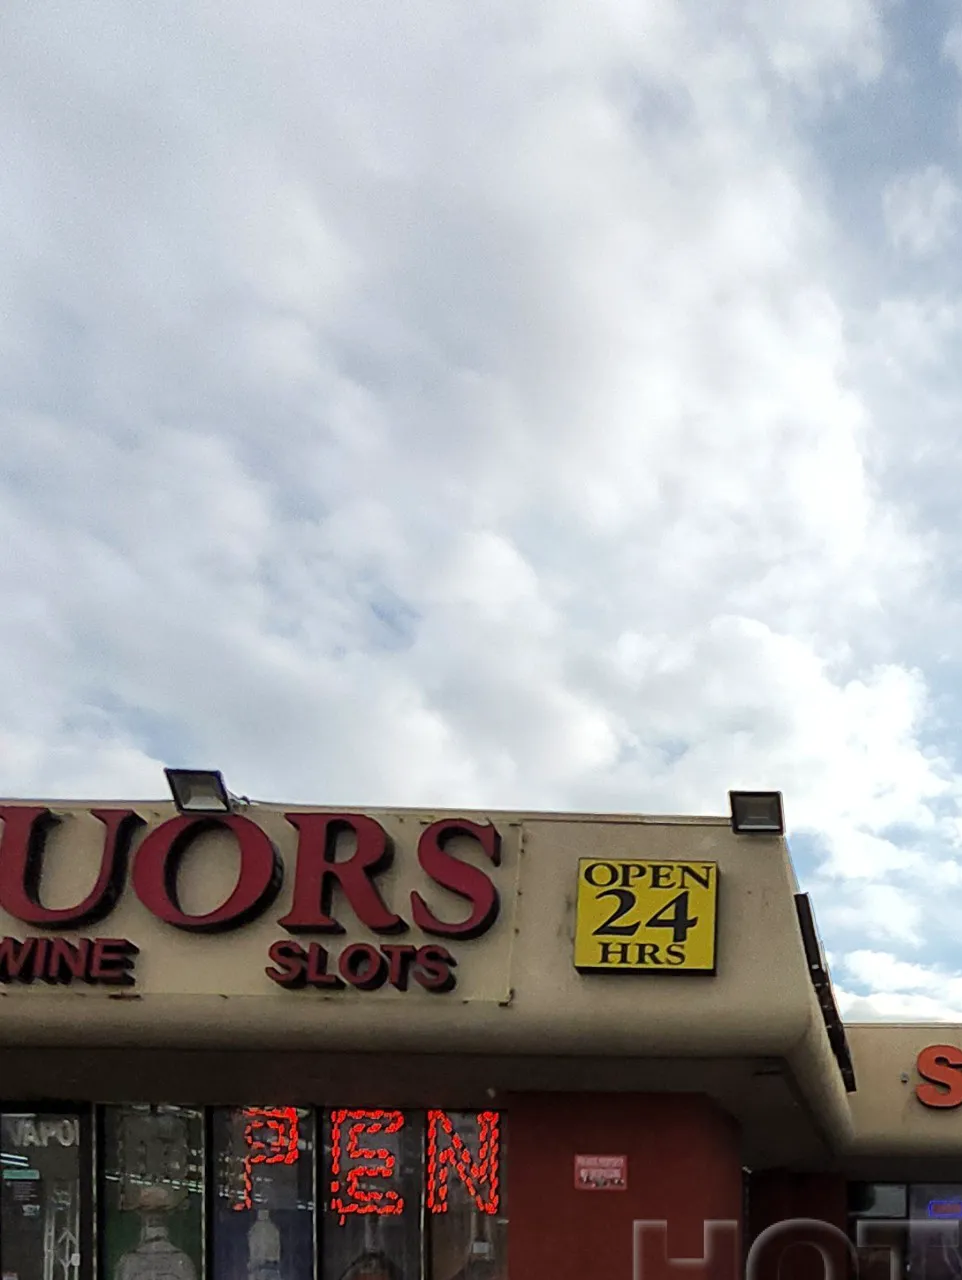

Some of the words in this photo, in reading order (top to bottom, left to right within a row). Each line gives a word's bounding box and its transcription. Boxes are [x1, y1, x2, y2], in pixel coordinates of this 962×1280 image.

[584, 862, 713, 889] OPEN
[592, 889, 698, 942] 24
[265, 940, 457, 992] SLOTS
[599, 942, 686, 966] HRS
